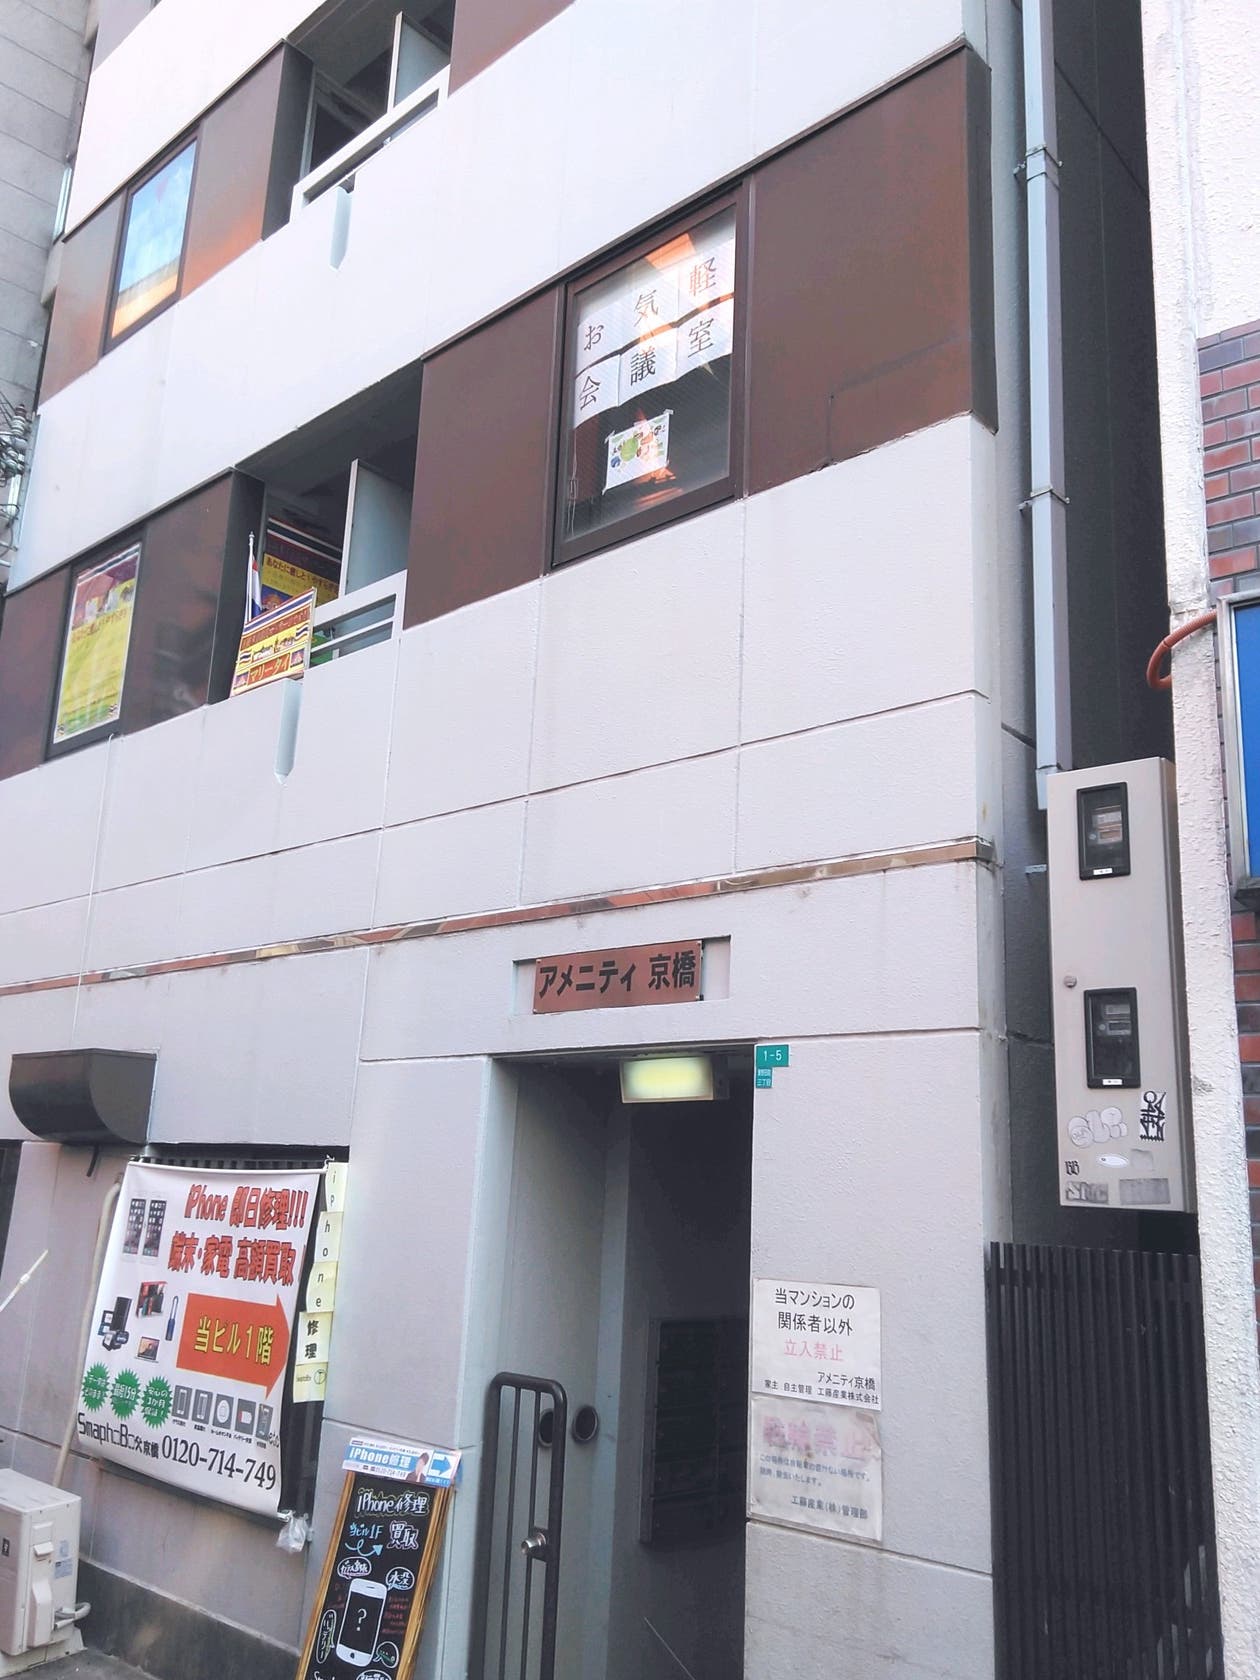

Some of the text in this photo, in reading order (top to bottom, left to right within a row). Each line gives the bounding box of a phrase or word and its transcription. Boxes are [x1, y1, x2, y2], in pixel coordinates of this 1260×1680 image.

[584, 257, 717, 351] お気軽
[579, 318, 715, 410] 会議室
[250, 653, 290, 681] マリータイ
[539, 950, 696, 998] アメニティ 京橋
[763, 1050, 782, 1061] 1-5
[184, 1184, 228, 1221] iPhone
[233, 1237, 296, 1286] 高額買取
[775, 1288, 855, 1310] 当マンションの
[778, 1311, 853, 1336] 関係者以外
[194, 1316, 274, 1366] 当ビル1階
[784, 1338, 843, 1362] 立入禁止
[817, 1371, 876, 1391] アメニティ京橋
[162, 1435, 276, 1490] 0120-714-749
[348, 1447, 412, 1469] iPhone修理
[357, 1491, 428, 1514] iPhone修理
[391, 1523, 417, 1548] 買取
